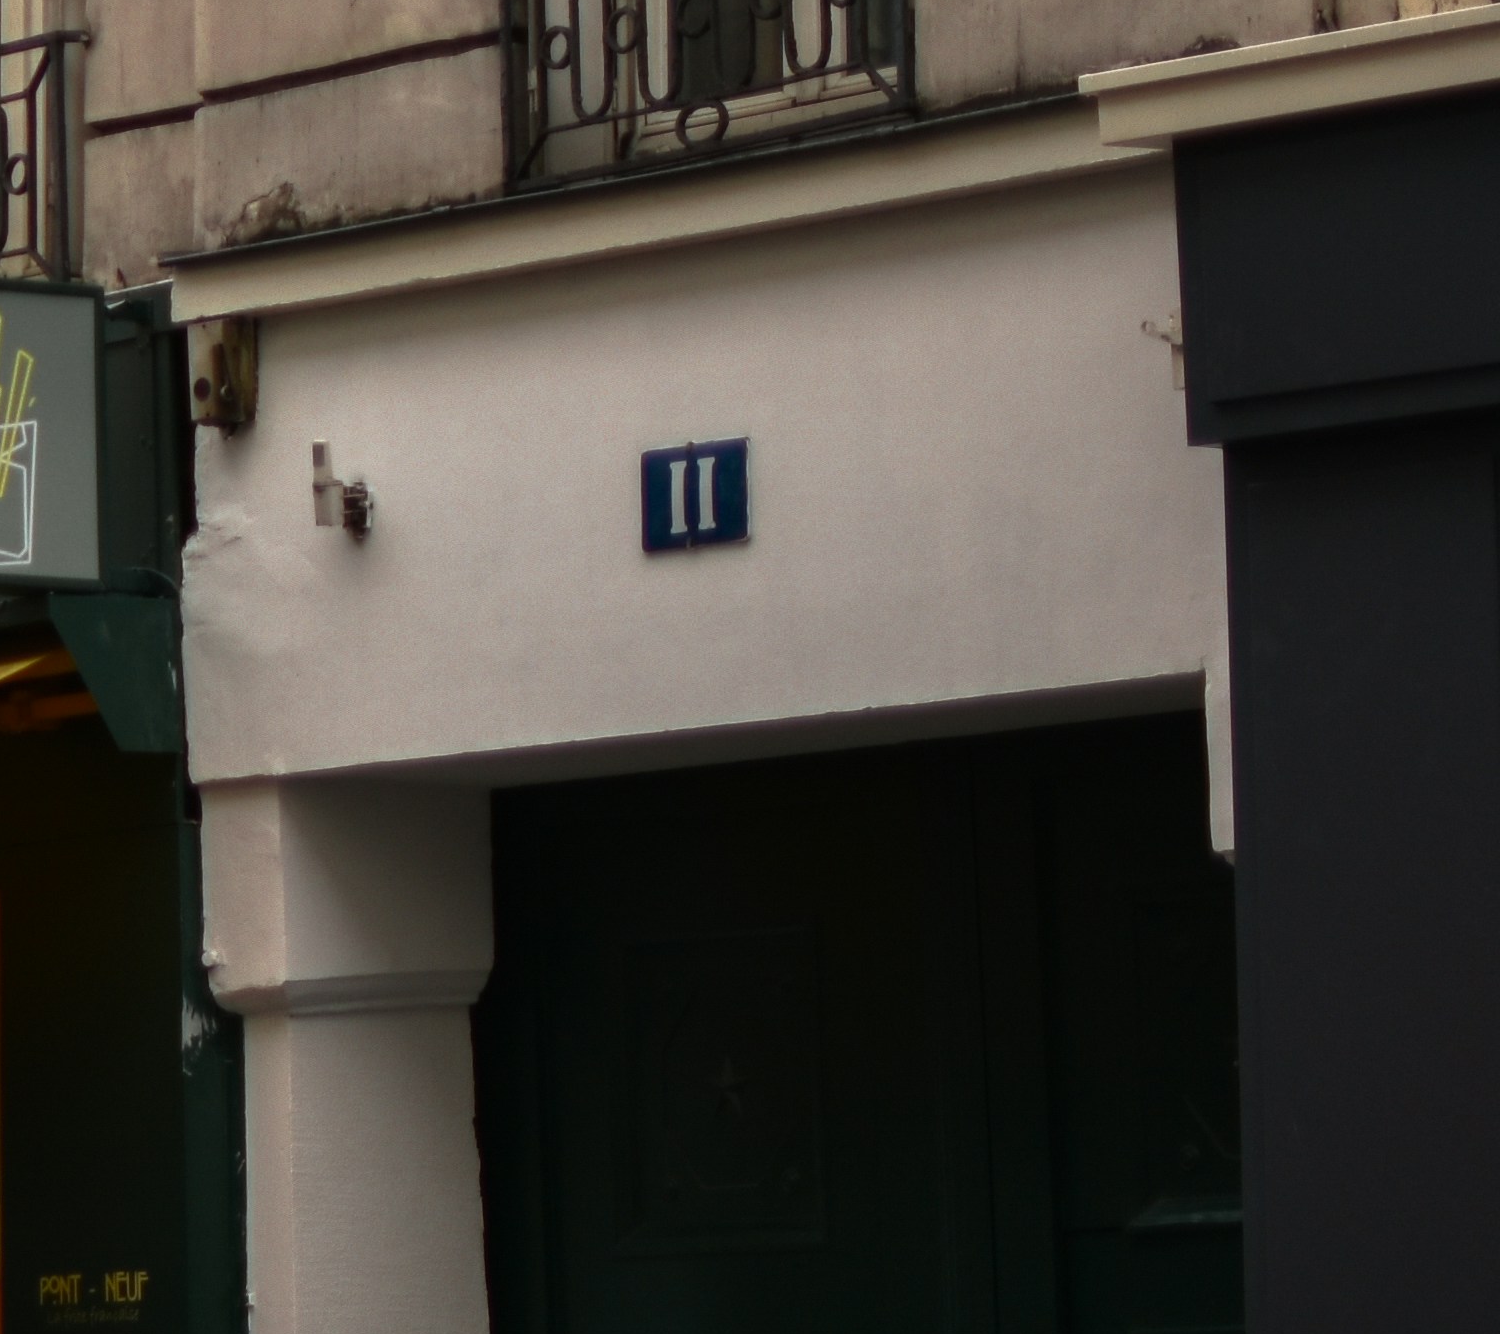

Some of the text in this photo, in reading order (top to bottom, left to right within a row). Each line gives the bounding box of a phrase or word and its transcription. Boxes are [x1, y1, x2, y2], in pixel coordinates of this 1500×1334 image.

[669, 456, 717, 535] 11
[39, 1274, 82, 1306] PONT
[104, 1271, 150, 1303] NEUF
